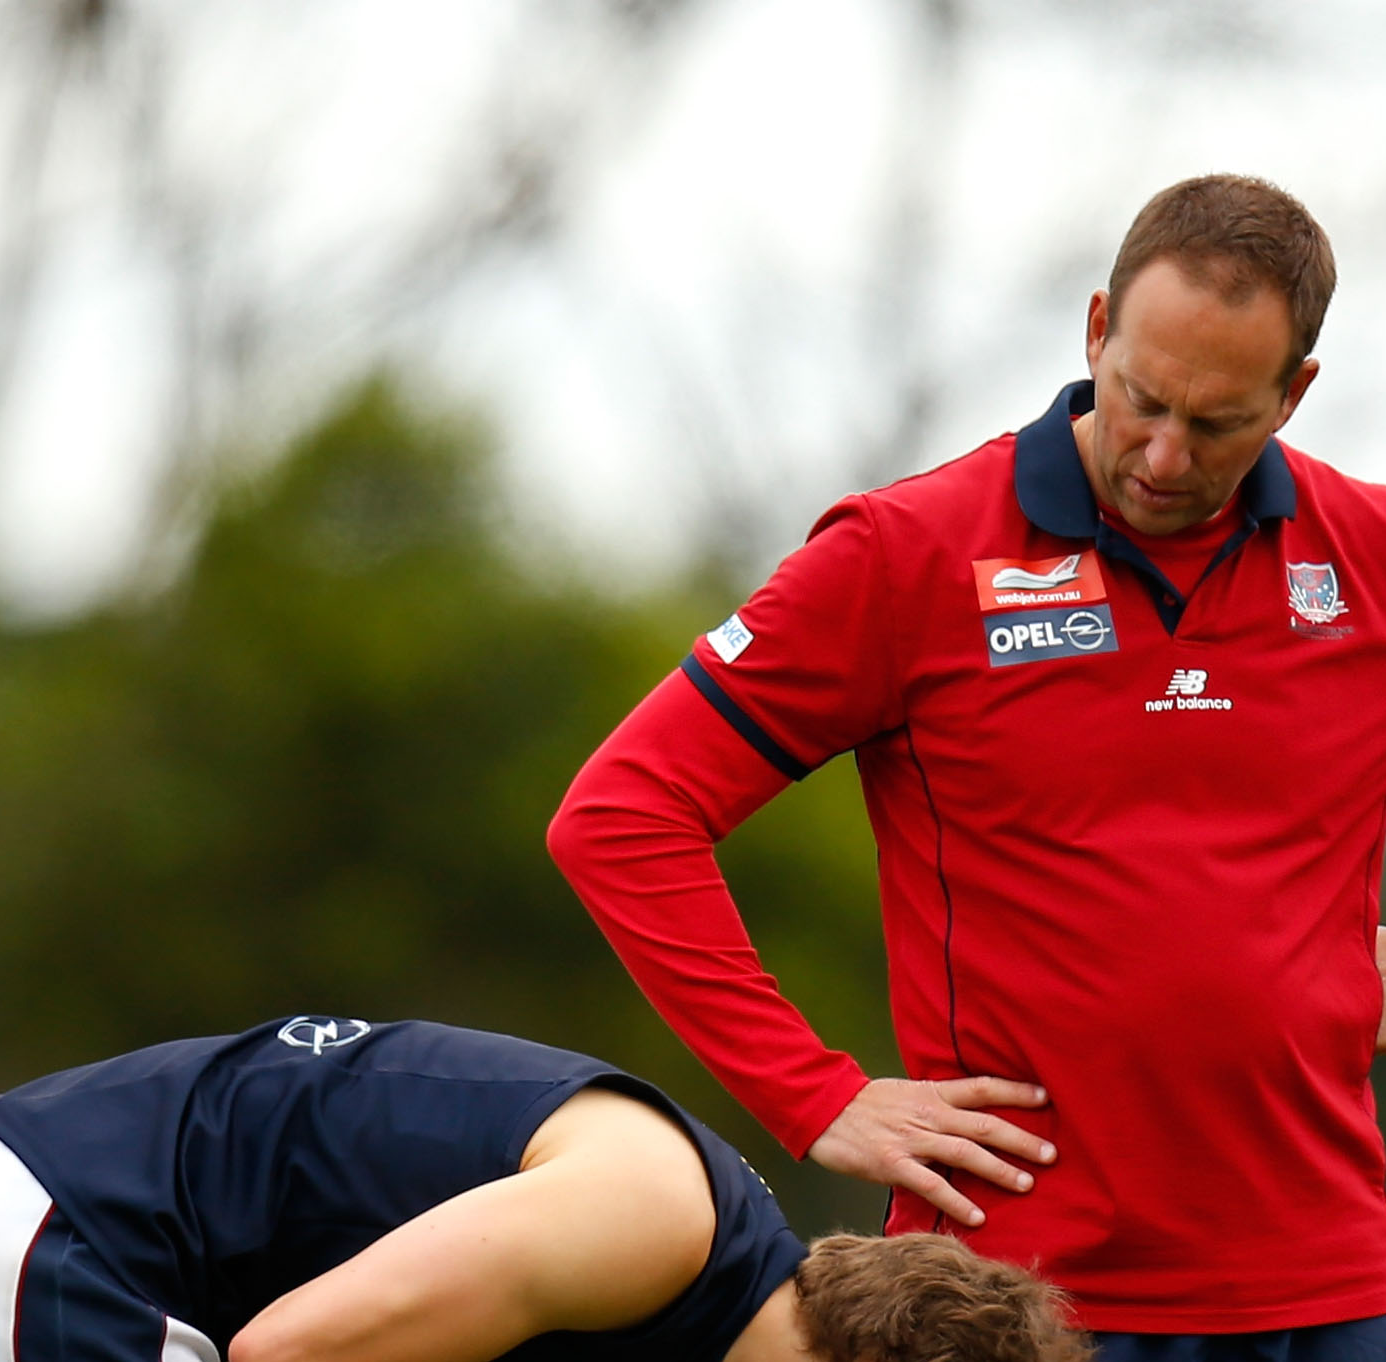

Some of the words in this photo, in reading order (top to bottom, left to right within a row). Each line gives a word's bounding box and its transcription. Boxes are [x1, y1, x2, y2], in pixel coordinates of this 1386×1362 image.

[995, 591, 1081, 605] webjet.com.au
[990, 622, 1064, 654] OPEL
[1145, 699, 1174, 712] new
[1176, 696, 1233, 711] balance
